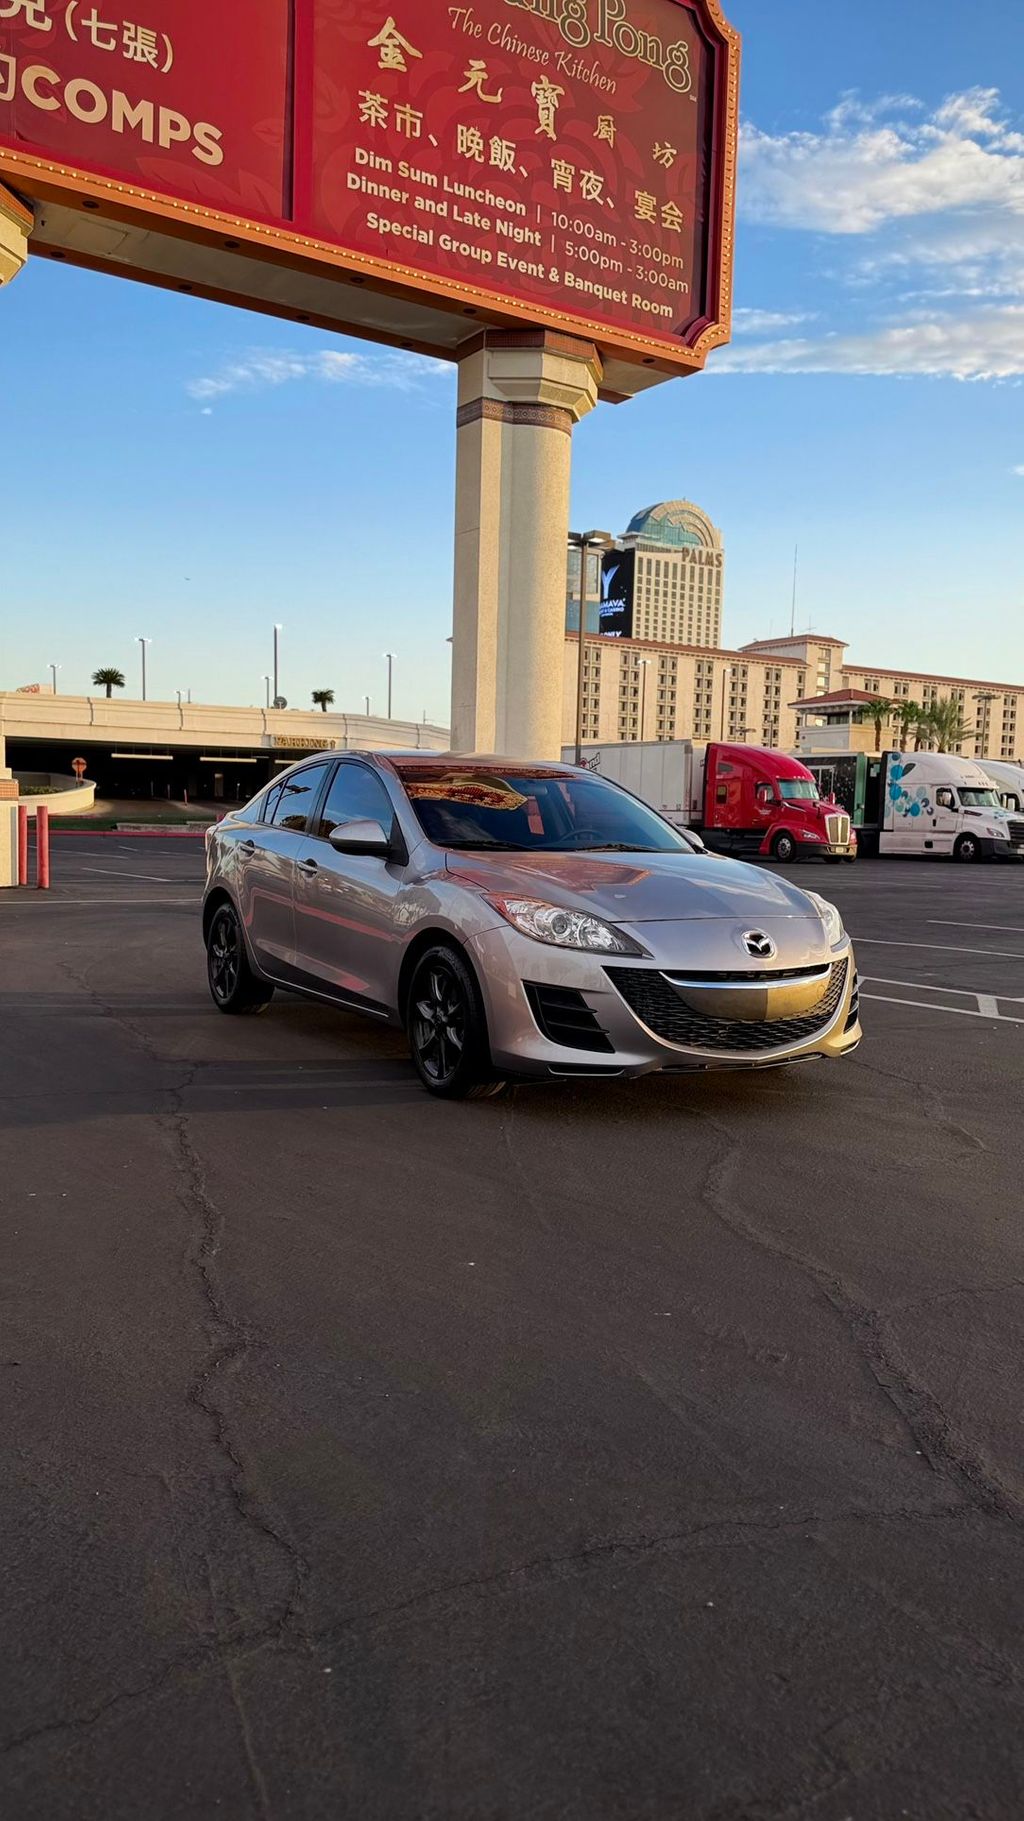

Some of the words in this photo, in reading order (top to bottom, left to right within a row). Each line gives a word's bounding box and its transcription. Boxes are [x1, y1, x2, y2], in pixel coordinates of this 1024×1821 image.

[448, 7, 482, 38] The
[487, 22, 550, 66] Chinese
[554, 51, 617, 94] Kitchen
[594, 0, 692, 93] Pong
[346, 172, 410, 204] Dinner
[414, 195, 448, 217] and
[453, 205, 491, 231] Late
[495, 218, 542, 247] Night
[565, 241, 623, 274] 5:00pm
[635, 265, 689, 294] 3:00am
[355, 147, 393, 173] Dim
[398, 161, 438, 188] Sum
[443, 175, 527, 217] Luncheon
[551, 212, 617, 247] 10:00am
[629, 239, 684, 269] 3:00pm
[366, 212, 434, 246] Special
[438, 233, 493, 264] Group
[496, 250, 545, 279] Event
[548, 267, 560, 283] &
[564, 271, 628, 304] Banquet
[631, 293, 673, 318] Room
[681, 547, 723, 569] PALMS
